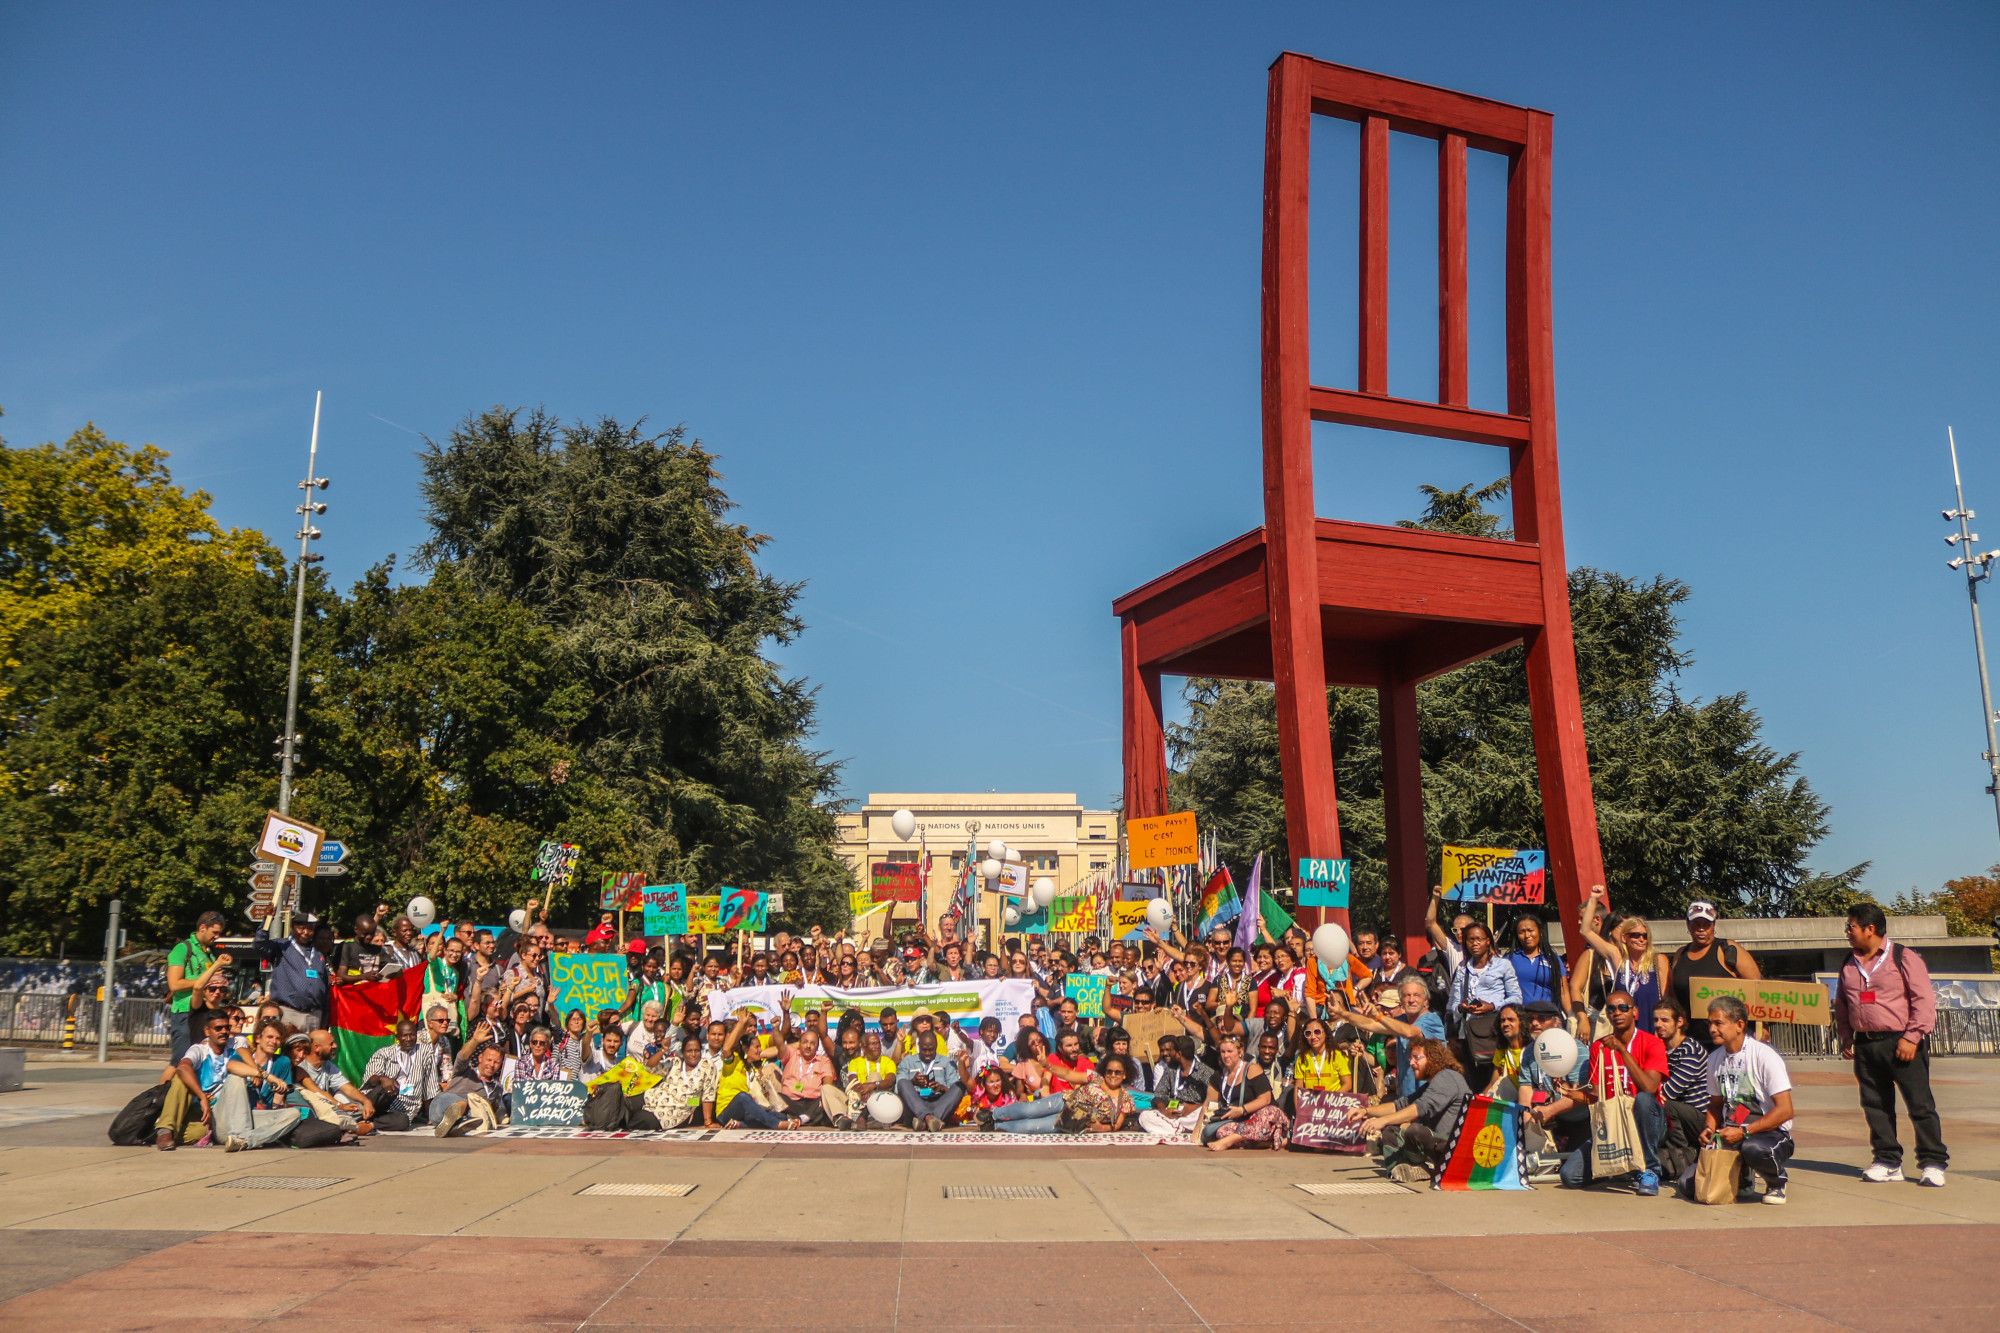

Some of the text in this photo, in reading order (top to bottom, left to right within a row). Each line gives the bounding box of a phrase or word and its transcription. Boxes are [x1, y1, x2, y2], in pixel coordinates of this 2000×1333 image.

[1143, 818, 1188, 831] MON PAYS?
[1153, 832, 1174, 841] C'EST
[1144, 845, 1194, 858] LE MONDE
[1309, 860, 1347, 884] PAIX
[1299, 876, 1340, 892] AMOUR
[721, 900, 766, 926] PAIX
[1053, 896, 1095, 918] LULA
[1055, 916, 1095, 932] LIVRE
[553, 953, 621, 986] SOUTH
[1067, 975, 1090, 988] NON
[564, 984, 627, 1005] AFRICA
[537, 1081, 574, 1095] PUEBLO
[525, 1094, 537, 1104] NO
[1312, 1108, 1326, 1123] NO
